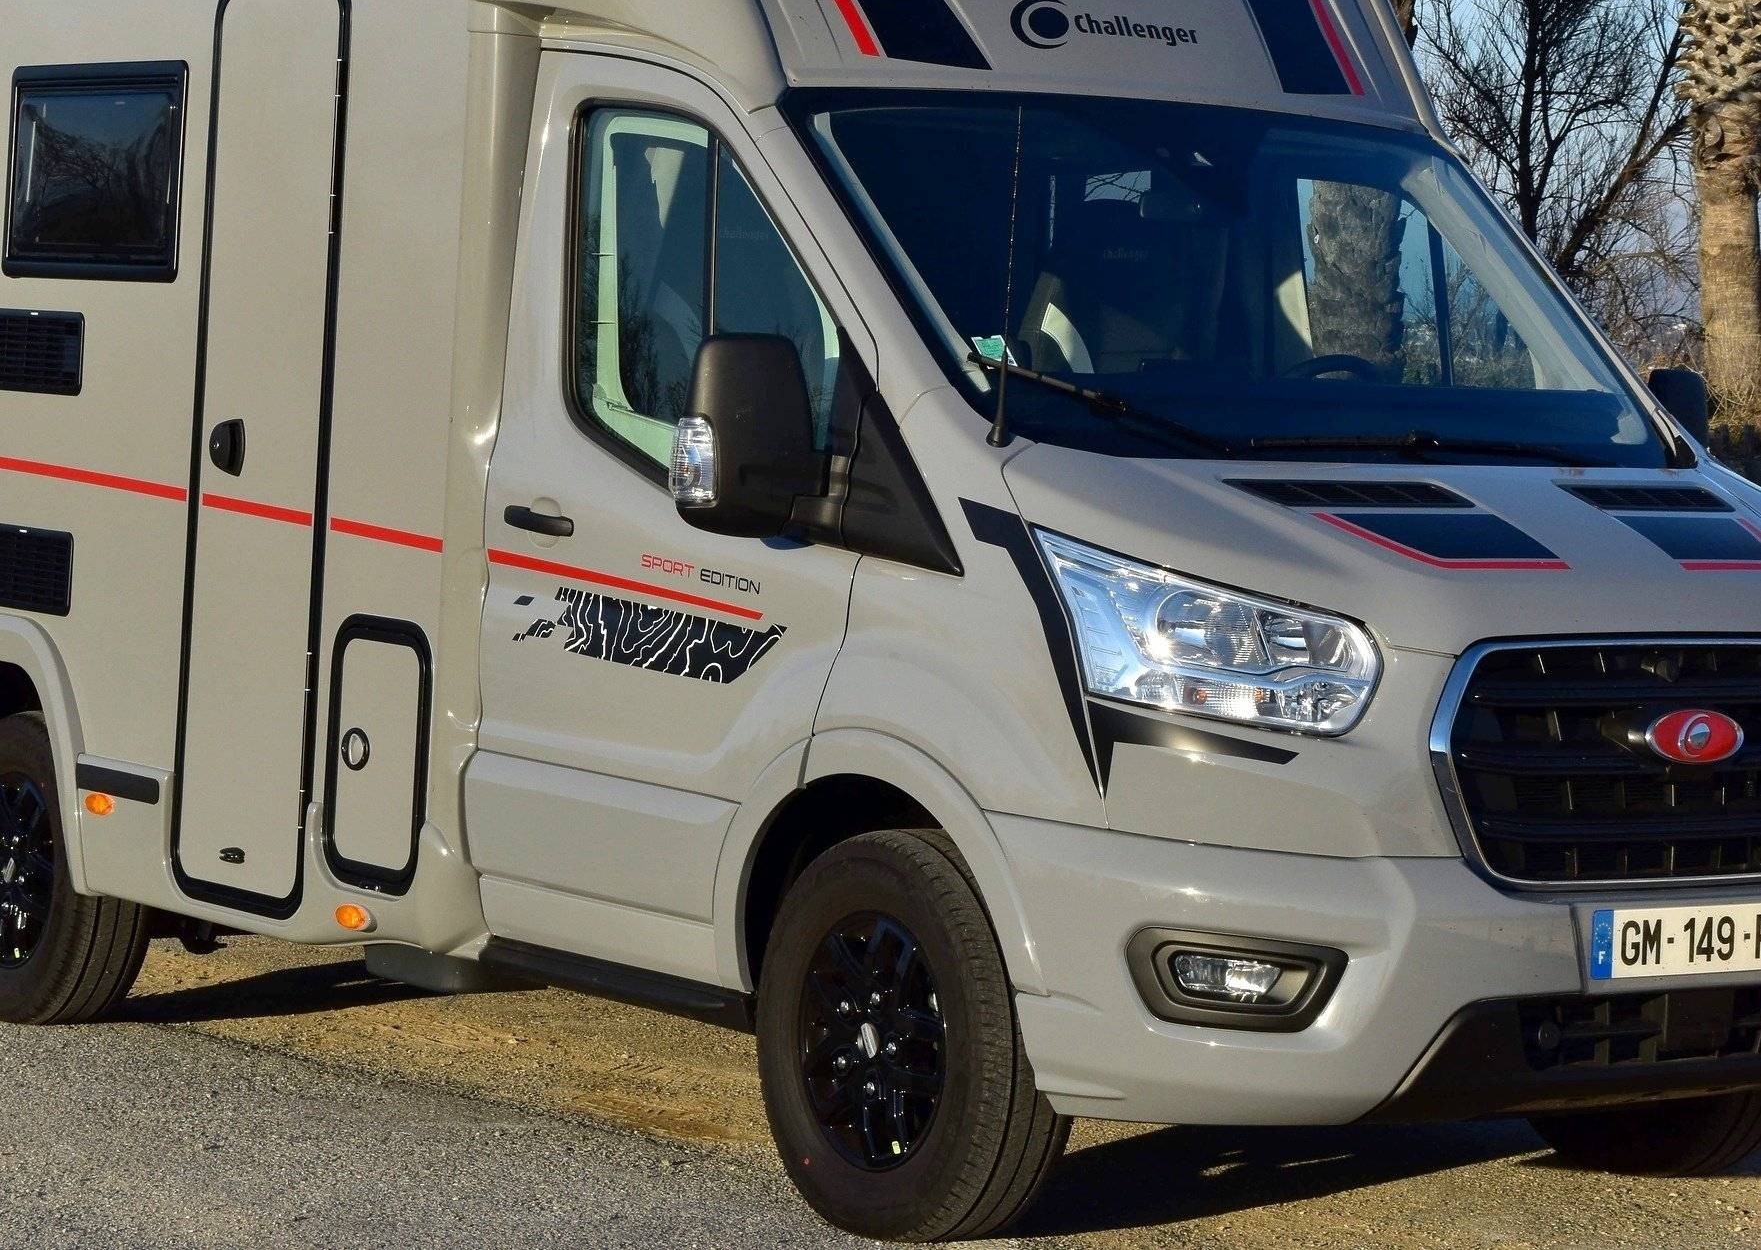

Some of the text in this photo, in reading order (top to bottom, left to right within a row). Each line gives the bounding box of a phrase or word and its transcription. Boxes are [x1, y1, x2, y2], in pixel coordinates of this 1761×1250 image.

[1074, 13, 1199, 47] Challenger
[641, 554, 760, 595] SPORT EDITION
[1598, 950, 1606, 965] F
